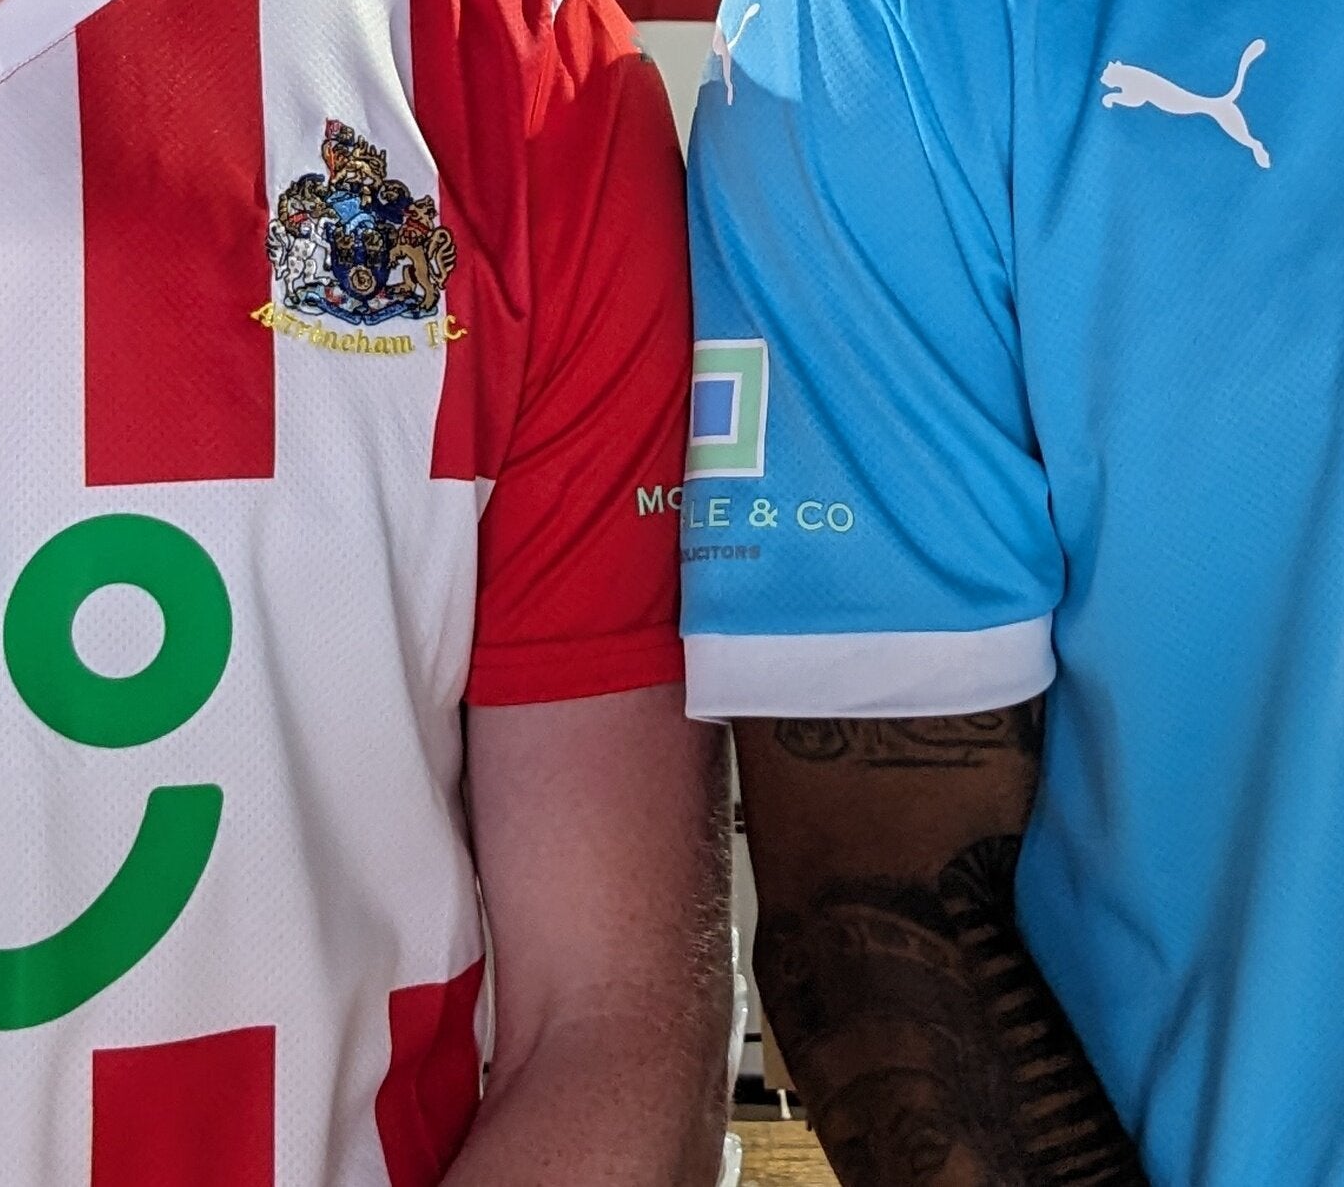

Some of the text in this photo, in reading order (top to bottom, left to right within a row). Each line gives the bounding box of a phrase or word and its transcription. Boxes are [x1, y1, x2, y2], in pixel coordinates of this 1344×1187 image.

[682, 498, 855, 532] LE & CO
